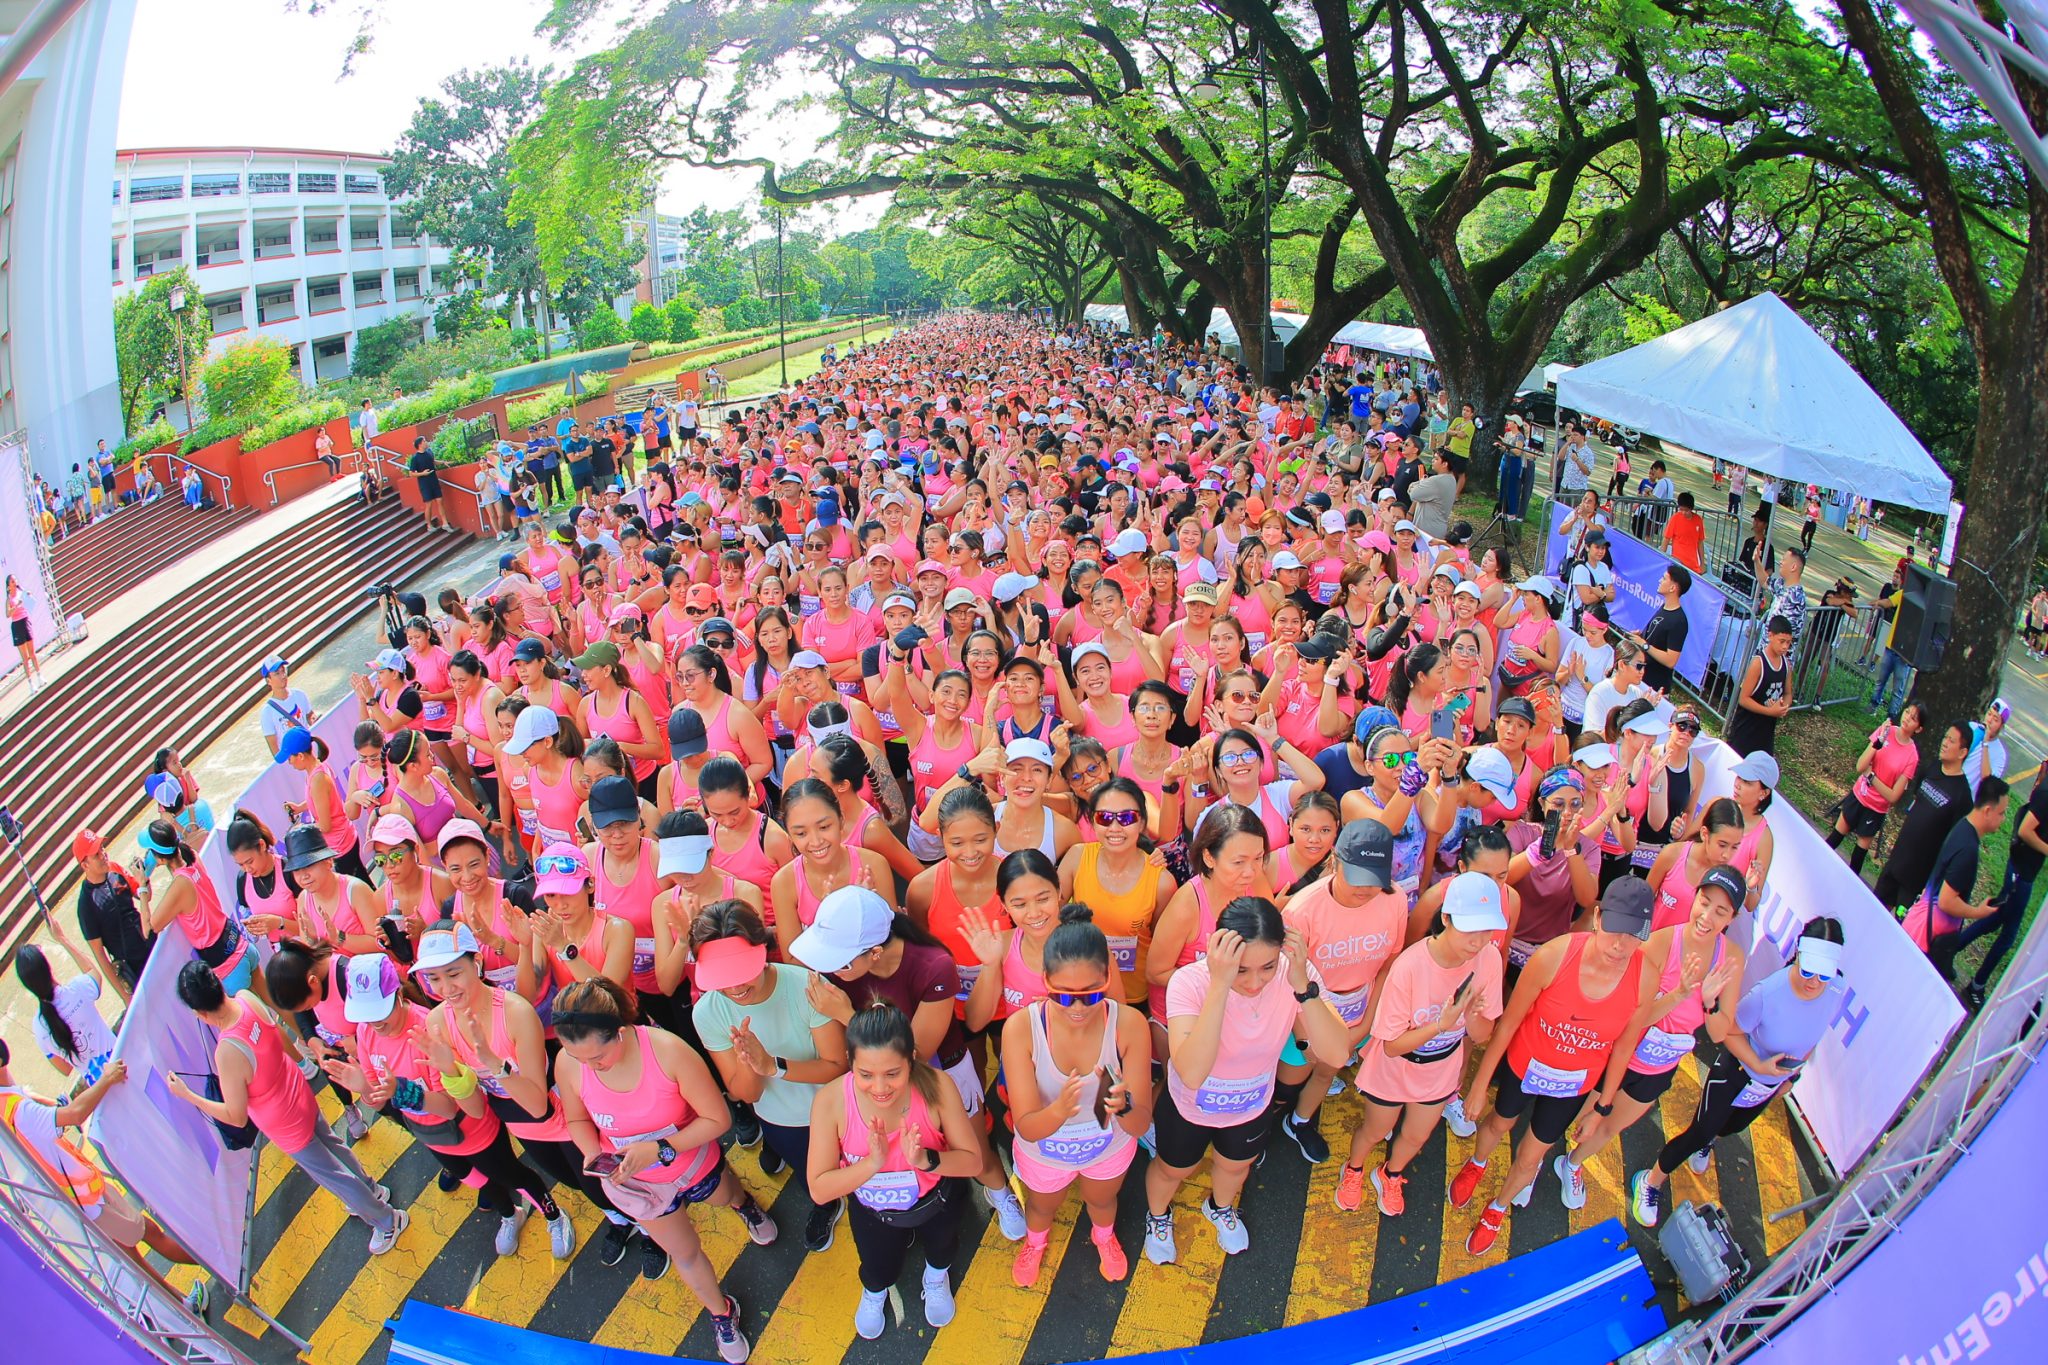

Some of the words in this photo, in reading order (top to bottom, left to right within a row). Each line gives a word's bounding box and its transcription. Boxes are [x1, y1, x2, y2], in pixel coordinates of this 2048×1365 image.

[1315, 931, 1389, 960] aetrex
[1556, 1021, 1600, 1040] ABACUS
[1555, 1043, 1578, 1056] LTD.
[1528, 1074, 1576, 1091] 50824
[1204, 1089, 1260, 1106] 50476
